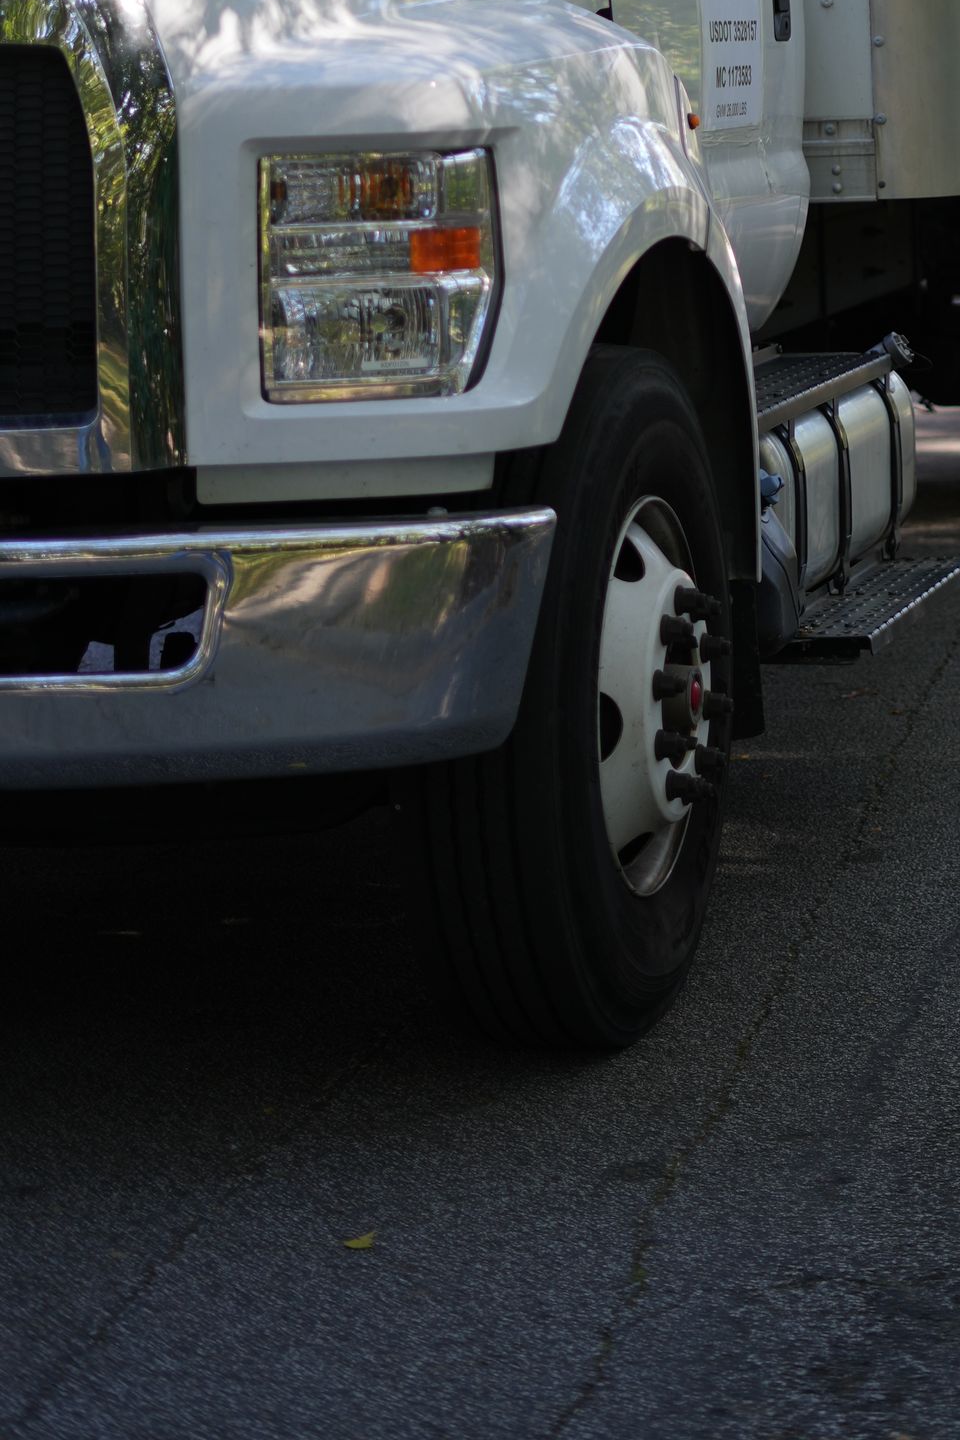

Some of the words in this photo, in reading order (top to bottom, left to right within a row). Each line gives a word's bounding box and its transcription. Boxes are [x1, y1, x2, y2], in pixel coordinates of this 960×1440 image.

[709, 20, 732, 42] USDOT
[716, 66, 727, 88] MC
[728, 65, 752, 87] 1173583
[739, 102, 747, 115] LBS
